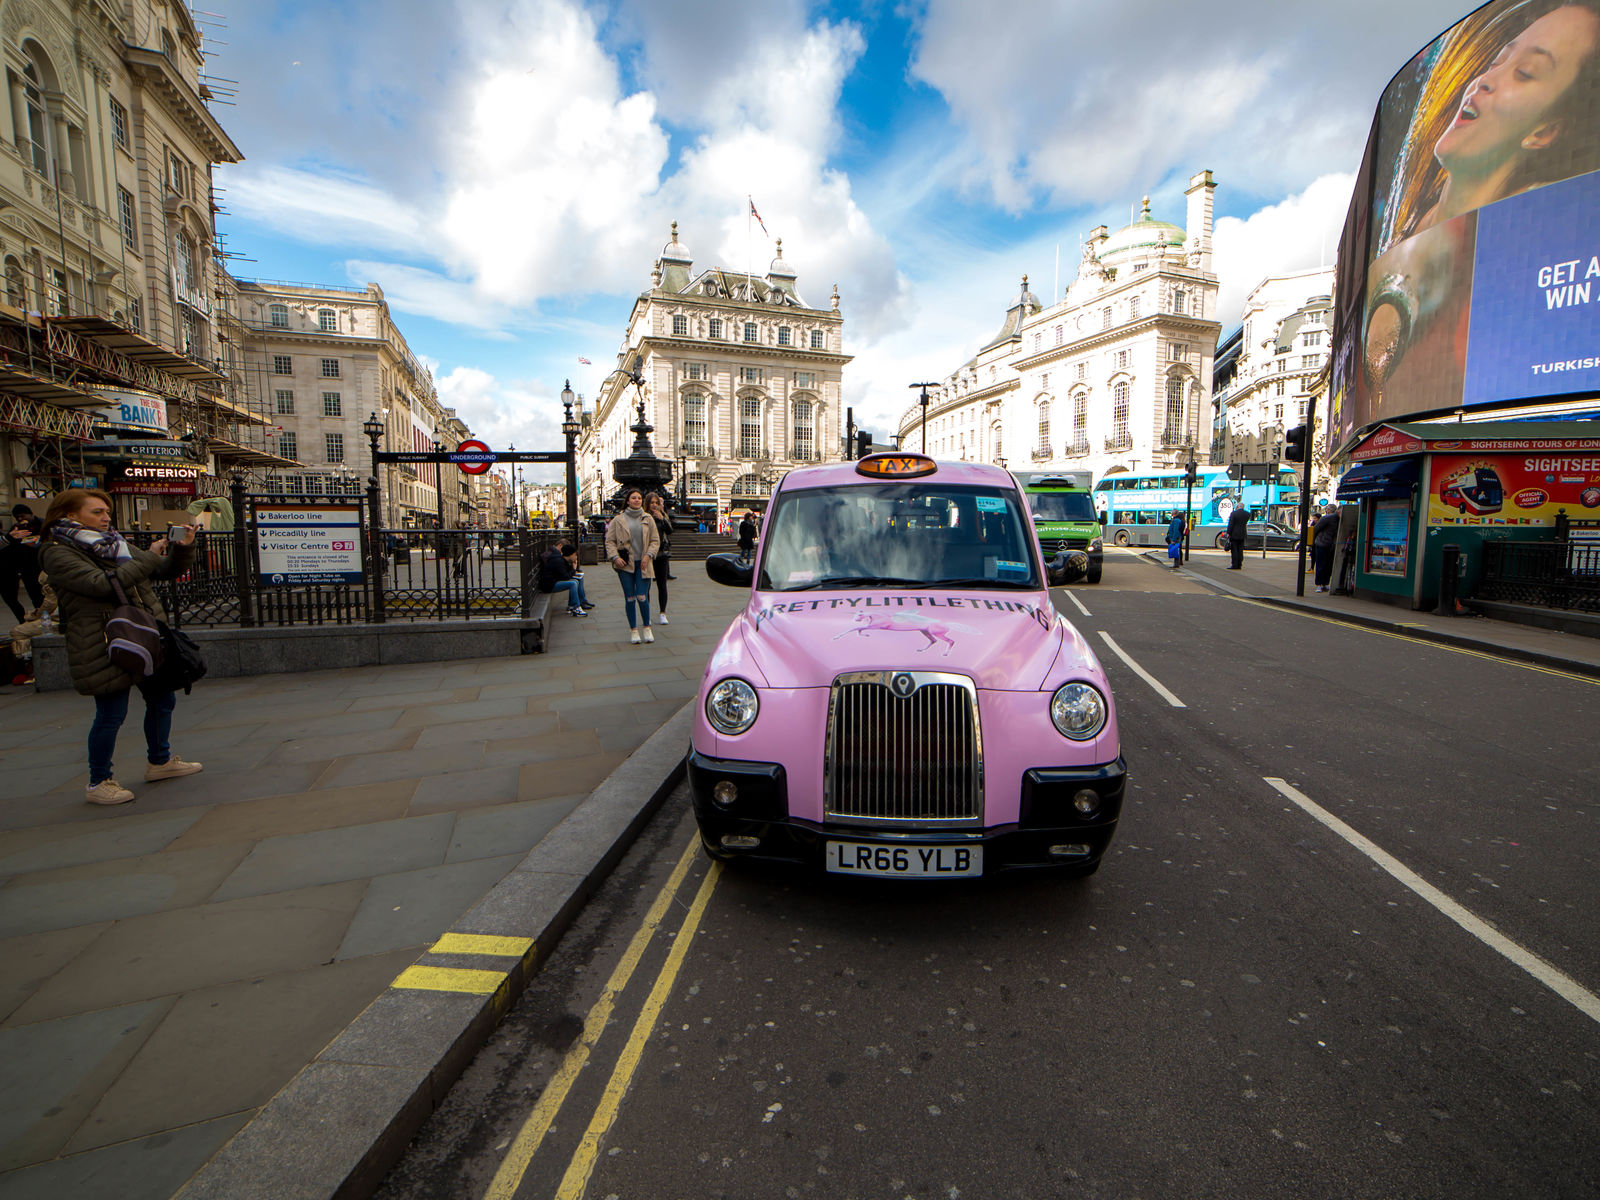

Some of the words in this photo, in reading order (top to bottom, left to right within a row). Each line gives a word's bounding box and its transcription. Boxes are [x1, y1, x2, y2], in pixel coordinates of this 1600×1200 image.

[1537, 260, 1581, 288] GET
[1545, 281, 1592, 311] WIN
[121, 404, 157, 426] BANK
[1471, 440, 1530, 449] SIGHTSEEING
[1532, 440, 1563, 448] TOURS
[1564, 440, 1578, 448] OF
[131, 446, 181, 456] CRITERION
[872, 459, 921, 472] TAXI
[125, 467, 197, 478] CRITERION
[1518, 491, 1543, 499] OFFICIAL
[268, 512, 305, 520] Bakerloo
[307, 512, 323, 520] line
[269, 530, 308, 538] Piccadilly
[1036, 526, 1093, 534] aitrose.com
[300, 542, 330, 550] Centre
[756, 596, 1050, 632] PRETTYLITTLETHING
[838, 844, 909, 871] LR66
[917, 848, 970, 872] YLB
